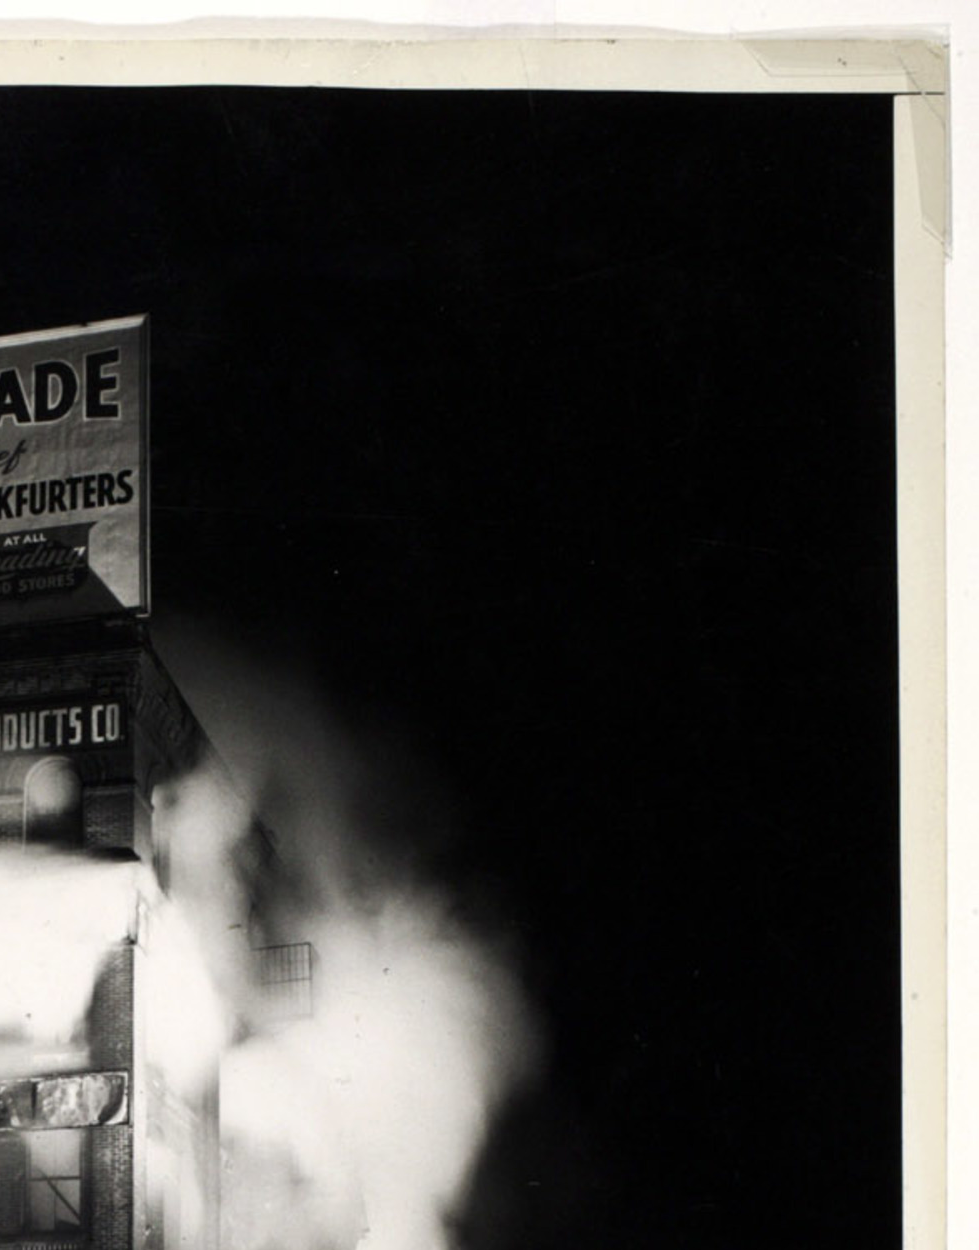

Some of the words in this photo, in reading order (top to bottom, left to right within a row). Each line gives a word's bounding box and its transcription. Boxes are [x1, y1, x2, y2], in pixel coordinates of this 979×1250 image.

[3, 534, 21, 547] AT
[22, 532, 47, 544] ALL
[18, 573, 75, 593] STORES
